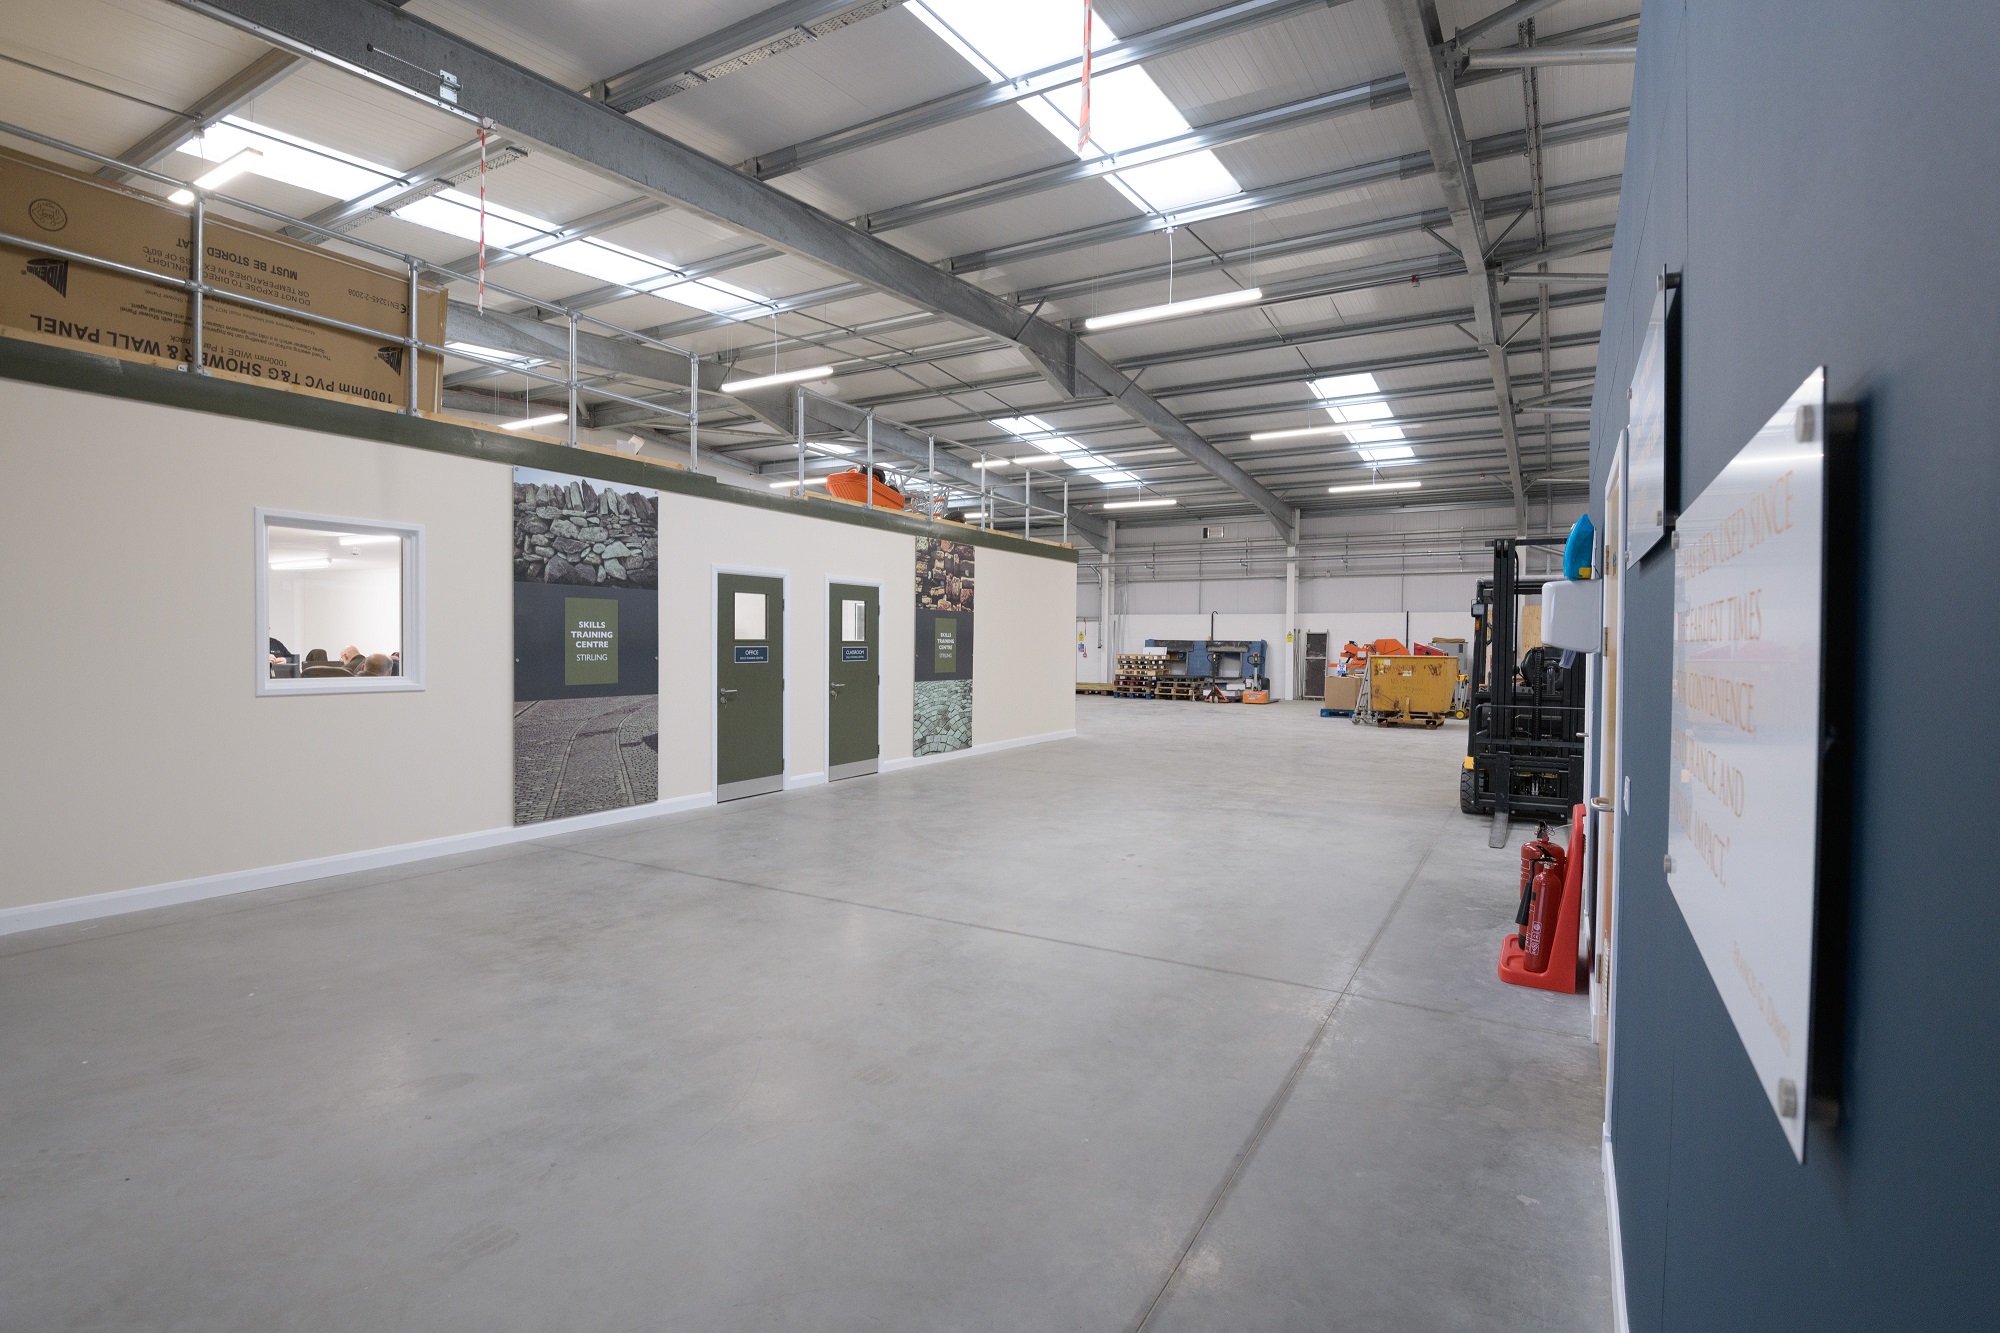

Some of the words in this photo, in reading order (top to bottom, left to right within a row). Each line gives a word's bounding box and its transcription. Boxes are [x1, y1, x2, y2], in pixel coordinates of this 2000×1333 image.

[165, 252, 176, 261] OF
[206, 247, 248, 266] STORED
[218, 266, 226, 274] IN
[253, 259, 266, 272] BE
[270, 264, 297, 280] MUST
[202, 270, 228, 284] DIREC
[228, 271, 295, 293] TEMPERATURES
[231, 278, 242, 288] TO
[246, 282, 278, 297] EXPOSE
[280, 292, 296, 302] NOT
[297, 288, 309, 297] OR
[299, 297, 310, 306] DO
[29, 313, 99, 343] PANEL
[106, 330, 160, 356] WALL
[170, 333, 190, 346] pack
[166, 343, 178, 359] &
[228, 347, 251, 359] WIDE
[254, 353, 287, 367] 1000mm
[268, 366, 300, 385] T&G
[305, 375, 333, 392] PVC
[339, 382, 392, 404] 1000mm
[1720, 507, 1746, 563] USED
[1749, 470, 1793, 549] SINCE
[1690, 599, 1725, 642] EARLIEST
[1728, 588, 1762, 642] TIMES
[1718, 759, 1744, 818] AND
